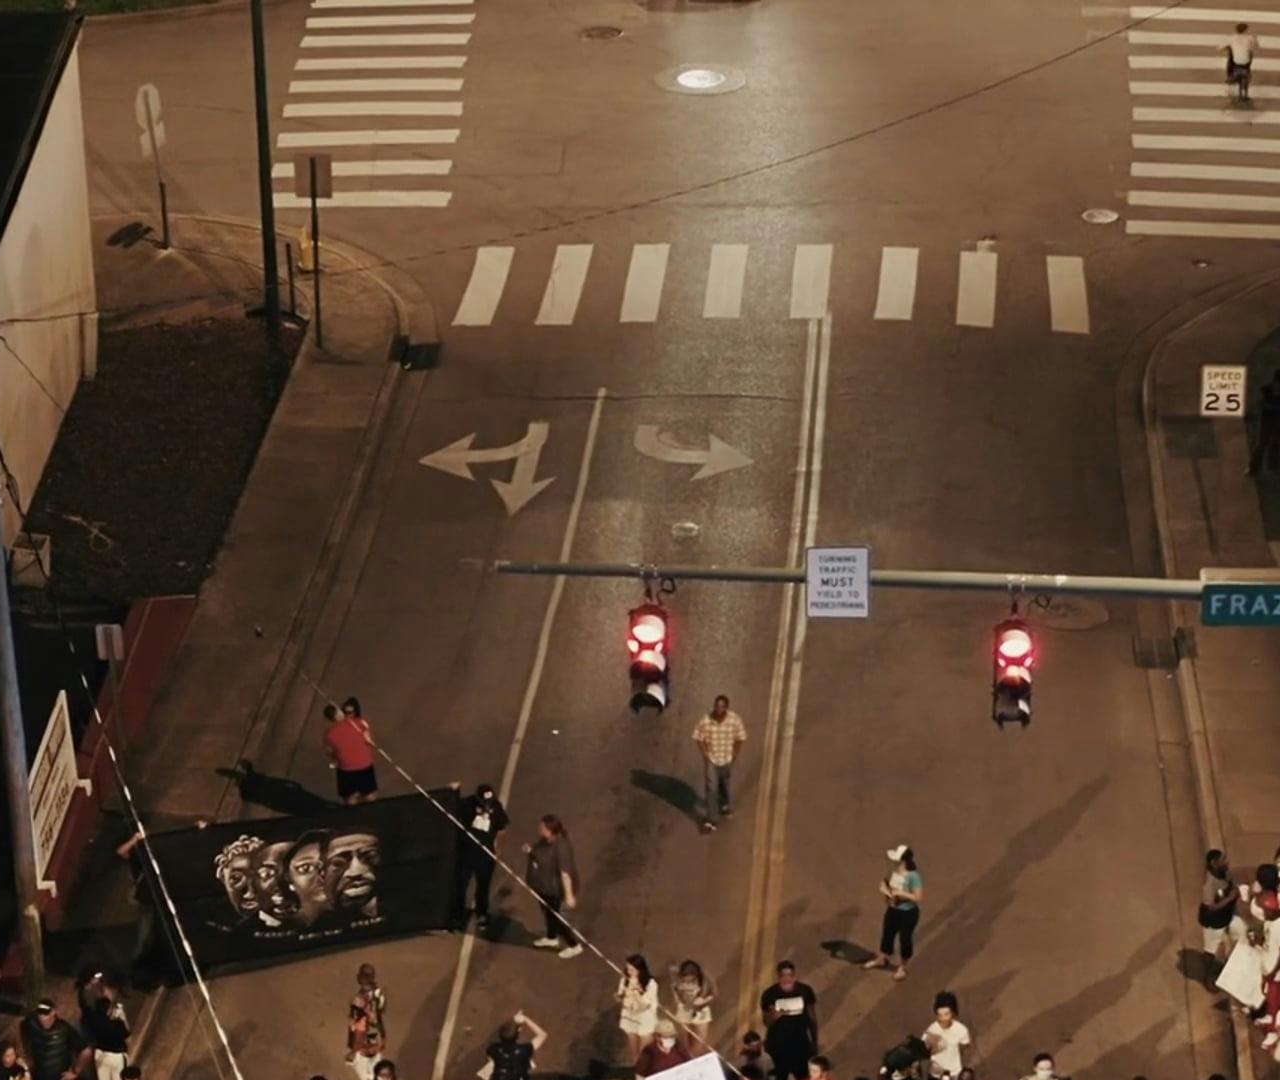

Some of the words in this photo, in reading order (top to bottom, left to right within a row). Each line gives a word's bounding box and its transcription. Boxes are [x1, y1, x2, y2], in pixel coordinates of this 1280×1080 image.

[1207, 372, 1241, 380] SPEED
[1204, 393, 1240, 412] 25
[818, 566, 856, 574] TRAFFIC
[821, 577, 853, 587] MUST
